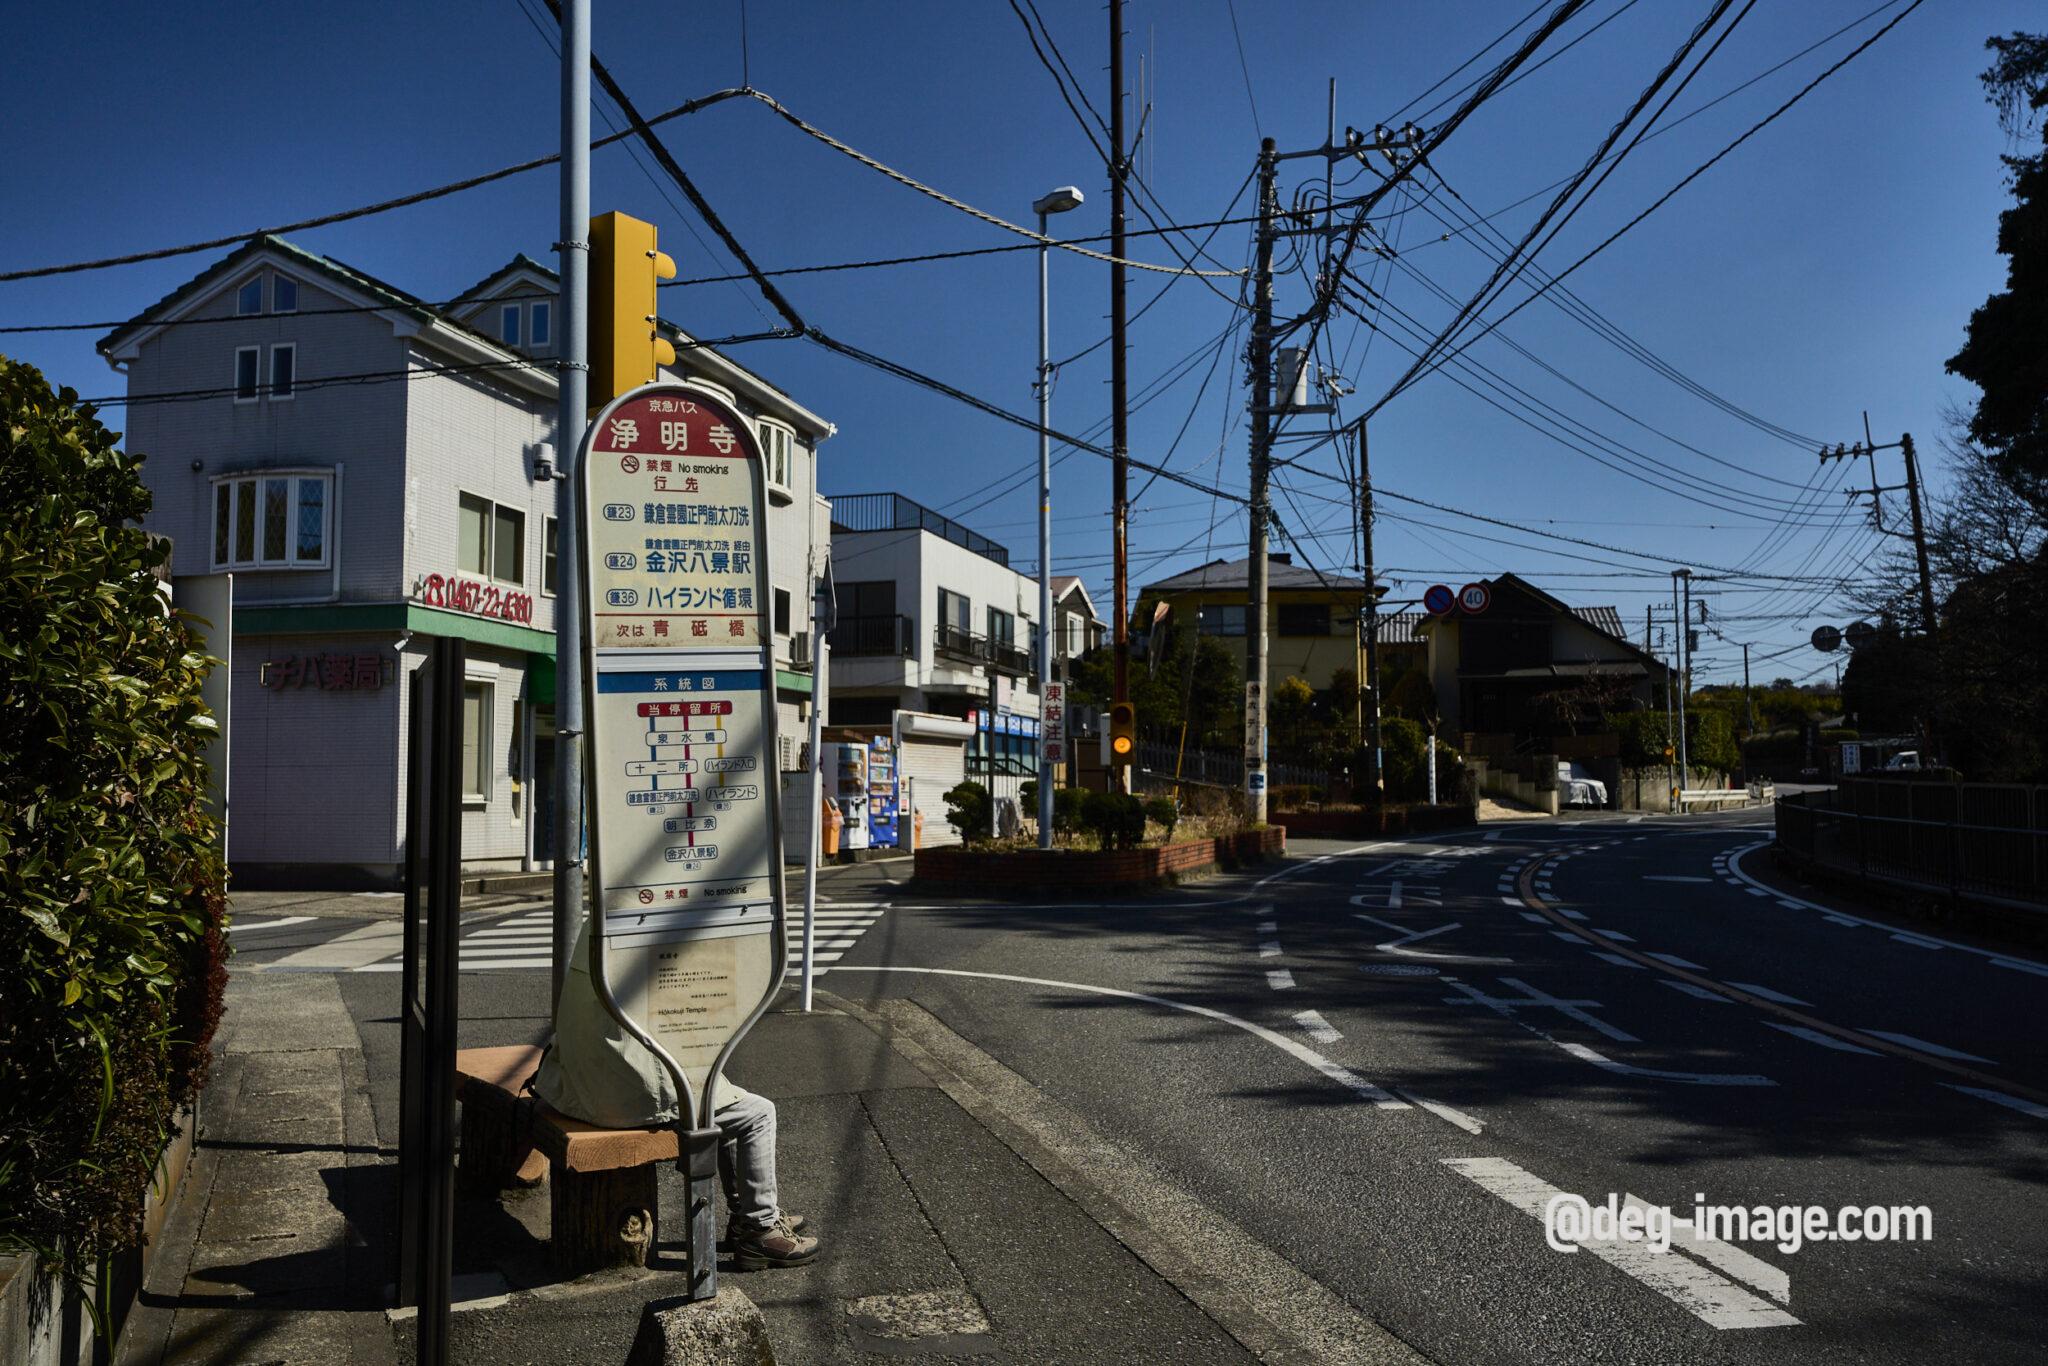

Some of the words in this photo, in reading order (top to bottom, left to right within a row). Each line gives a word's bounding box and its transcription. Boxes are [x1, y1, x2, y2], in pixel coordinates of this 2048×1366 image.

[649, 399, 698, 415] 京急バス
[610, 418, 737, 454] 浄明寺
[646, 458, 673, 473] 禁煙
[677, 462, 692, 474] No
[692, 463, 729, 476] smoking
[654, 475, 699, 491] 行先
[644, 503, 750, 527] 鎌倉霊園正門前太刀洗
[733, 540, 751, 552] 経由
[646, 551, 752, 574] 金沢八景駅
[446, 577, 532, 626] 0467-22-4380
[647, 587, 753, 609] ハイランド循環
[1466, 591, 1483, 605] 40
[616, 624, 645, 638] 次は
[653, 619, 746, 638] 青砥橋
[653, 676, 715, 691] 系統図
[648, 702, 722, 716] 当停留所
[1044, 684, 1063, 763] 凍結注意
[657, 731, 716, 744] 泉水橋
[635, 762, 689, 774] 十二所
[706, 759, 755, 771] ハイランド入口
[708, 786, 757, 798] ハイランド
[666, 818, 715, 831] 朝比奈
[666, 848, 716, 861] 金沢八景駅
[664, 888, 689, 900] 禁煙
[703, 888, 714, 897] No
[716, 885, 747, 897] smoking
